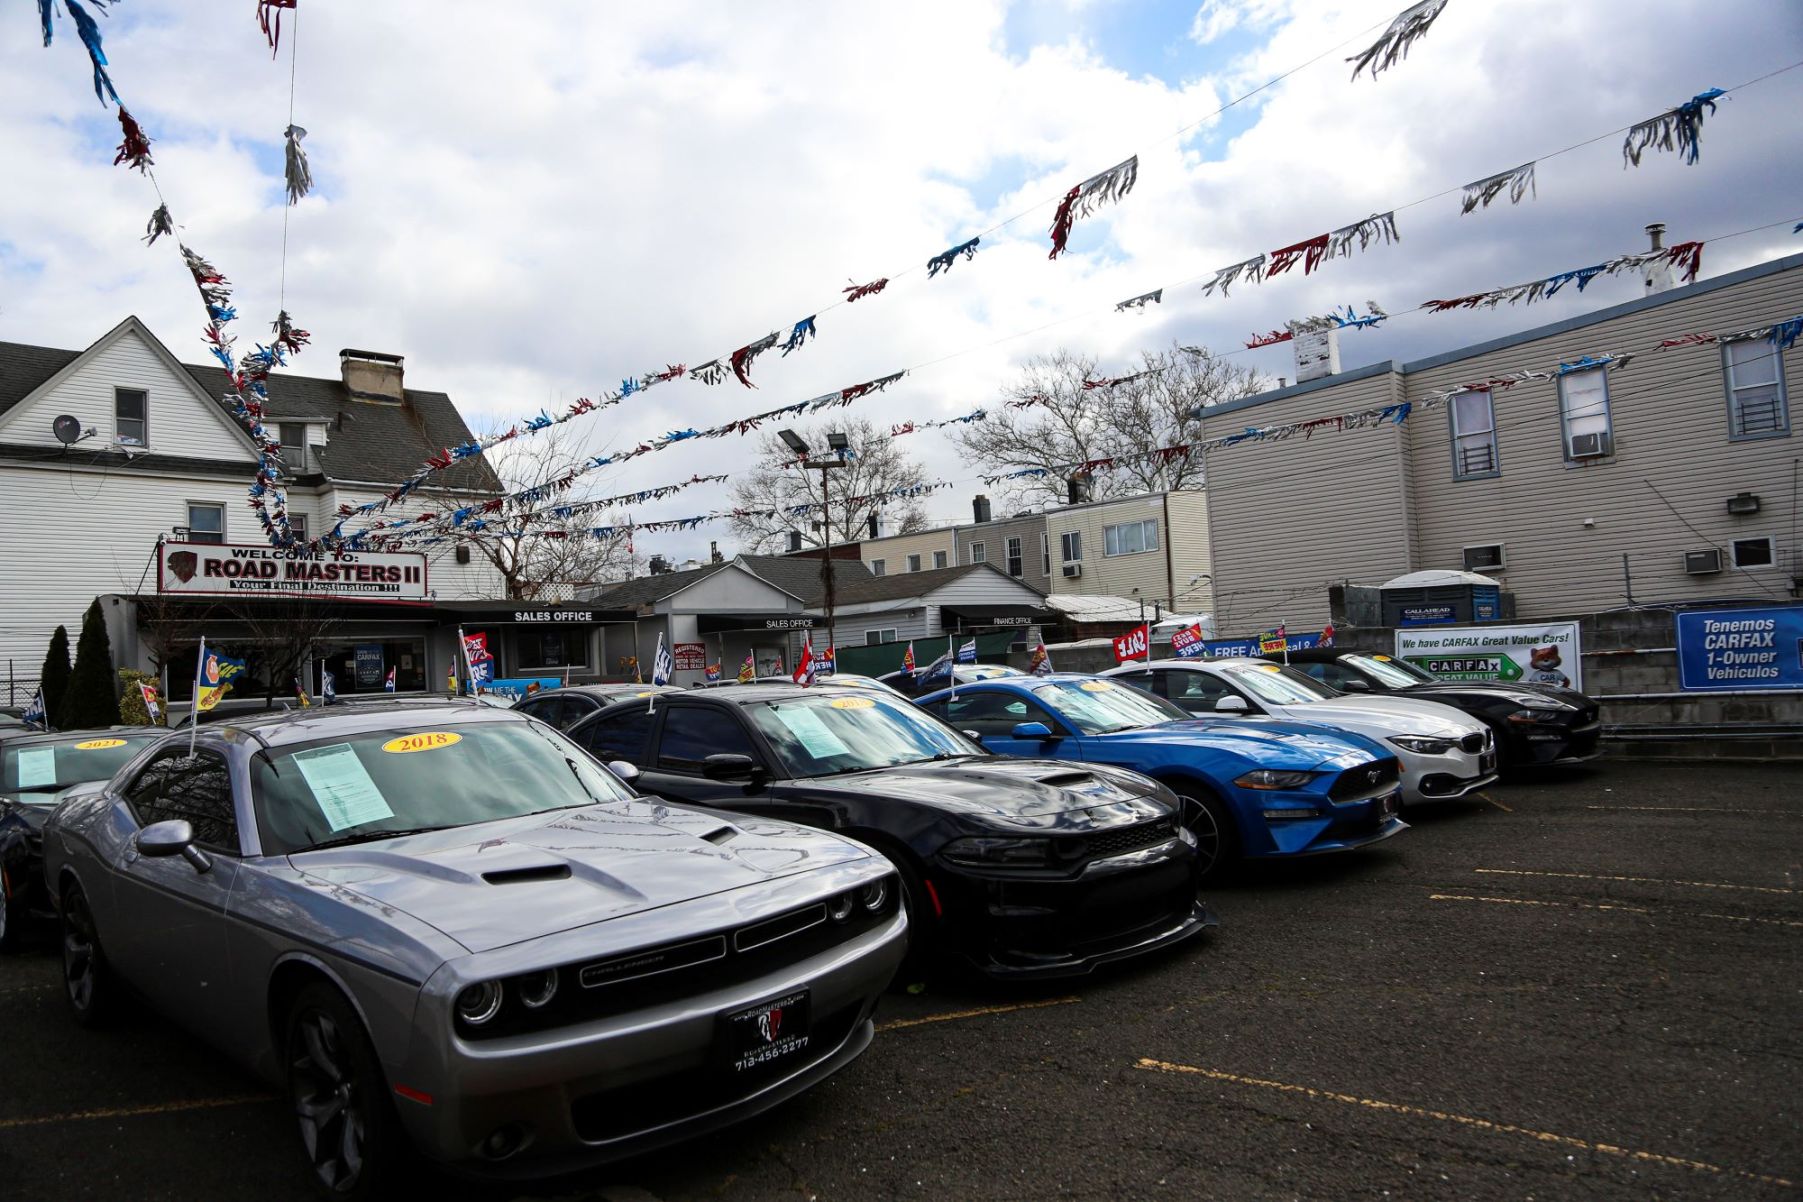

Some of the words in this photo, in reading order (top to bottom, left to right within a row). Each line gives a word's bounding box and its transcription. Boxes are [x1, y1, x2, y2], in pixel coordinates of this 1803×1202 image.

[231, 548, 325, 561] WELCOME
[331, 553, 359, 562] TO:
[204, 558, 279, 579] ROAD
[284, 561, 402, 583] MASTERS
[404, 565, 420, 584] II
[233, 580, 267, 590] Your
[269, 581, 304, 590] Final
[307, 582, 380, 593] Destination
[514, 611, 551, 622] SALES
[553, 611, 593, 621] OFFICE
[766, 620, 788, 628] SALES
[790, 619, 813, 627] OFFICE
[993, 617, 1015, 625] FINANCE
[1703, 619, 1775, 633] Tenemos
[1402, 639, 1416, 649] We
[1417, 638, 1440, 648] have
[1442, 636, 1480, 648] CARFAX
[1481, 636, 1509, 646] Great
[1511, 634, 1540, 645] Value
[1541, 632, 1569, 643] Cars!
[1704, 632, 1775, 650] CARFAX
[675, 644, 705, 654] REGISTERED
[1214, 645, 1247, 658] FREE
[1428, 658, 1501, 672] CARFAX
[1707, 651, 1777, 666] 1-Owner
[1707, 665, 1779, 680] Vehiculos
[86, 740, 118, 748] 2021
[400, 733, 448, 751] 2018
